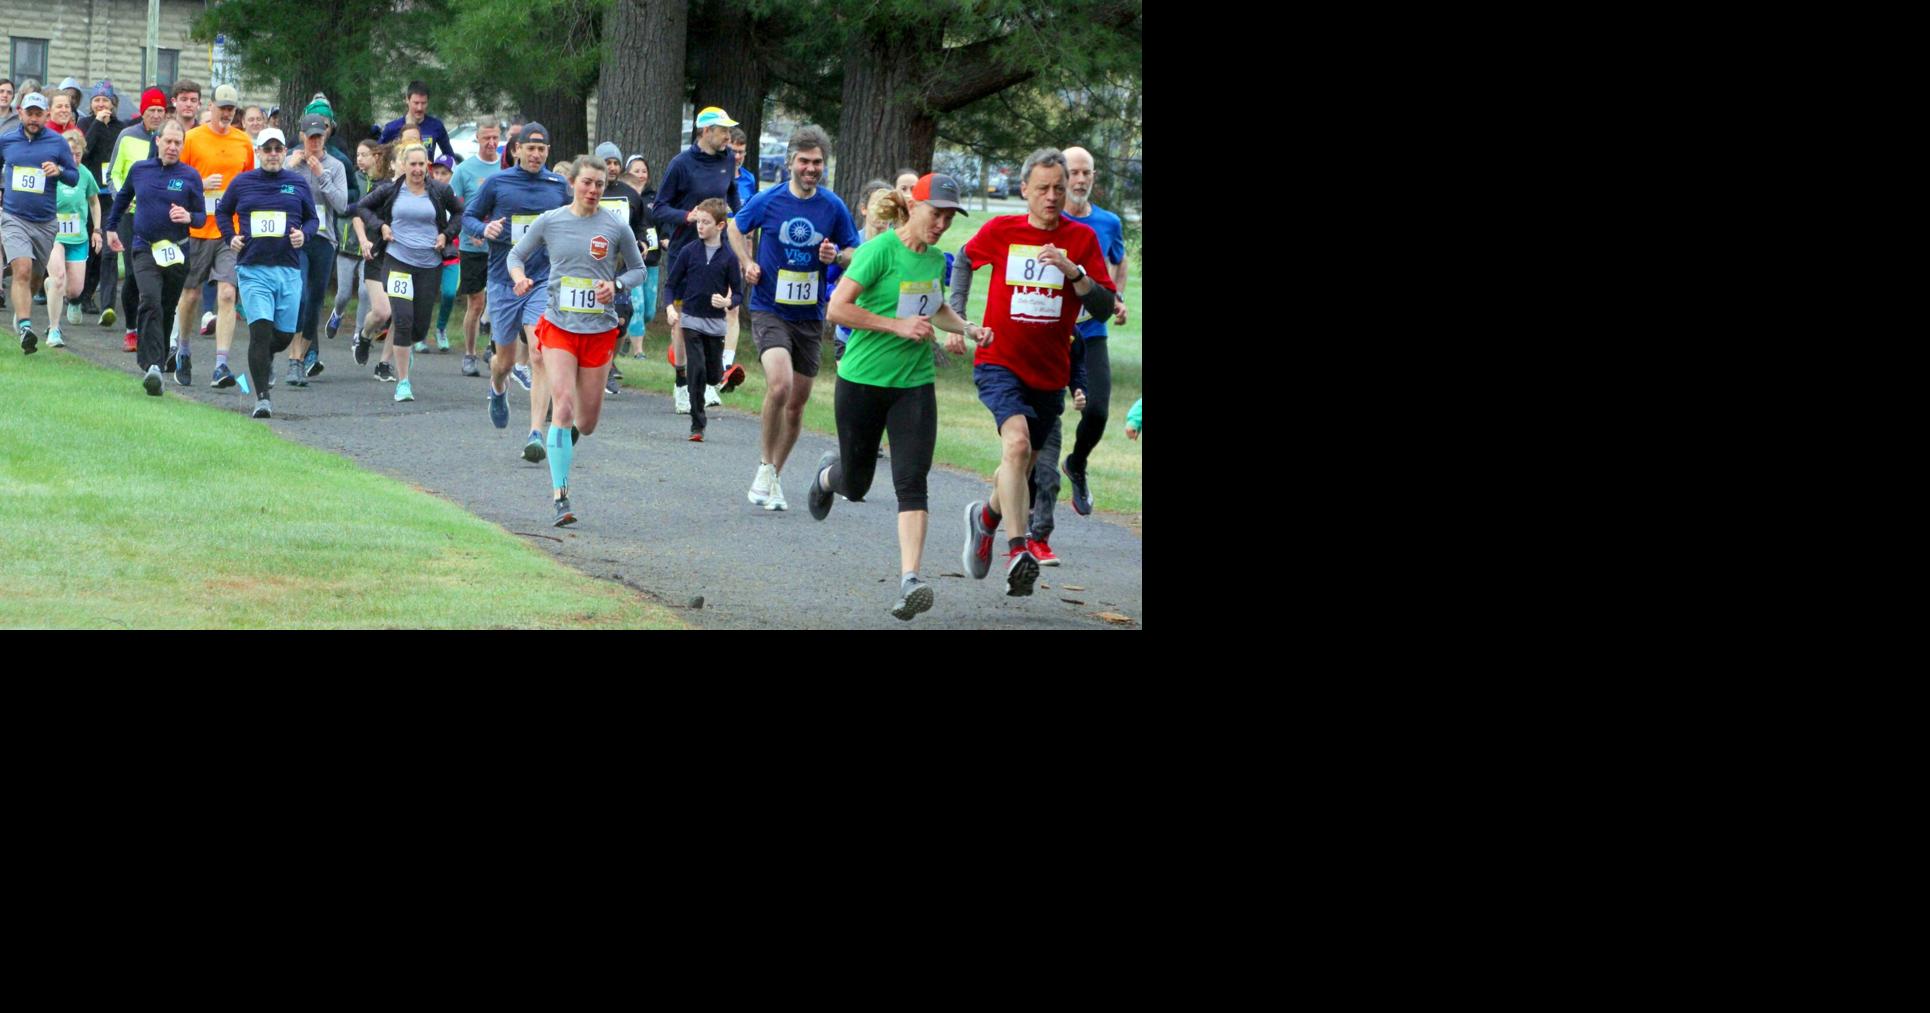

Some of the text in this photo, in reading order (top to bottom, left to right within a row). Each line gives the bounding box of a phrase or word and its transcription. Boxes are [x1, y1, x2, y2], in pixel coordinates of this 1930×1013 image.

[22, 175, 35, 189] 59
[261, 219, 275, 233] 30
[161, 247, 176, 262] 79
[393, 280, 408, 294] 83
[787, 283, 811, 301] 113
[570, 289, 596, 308] 119
[918, 295, 929, 316] 2
